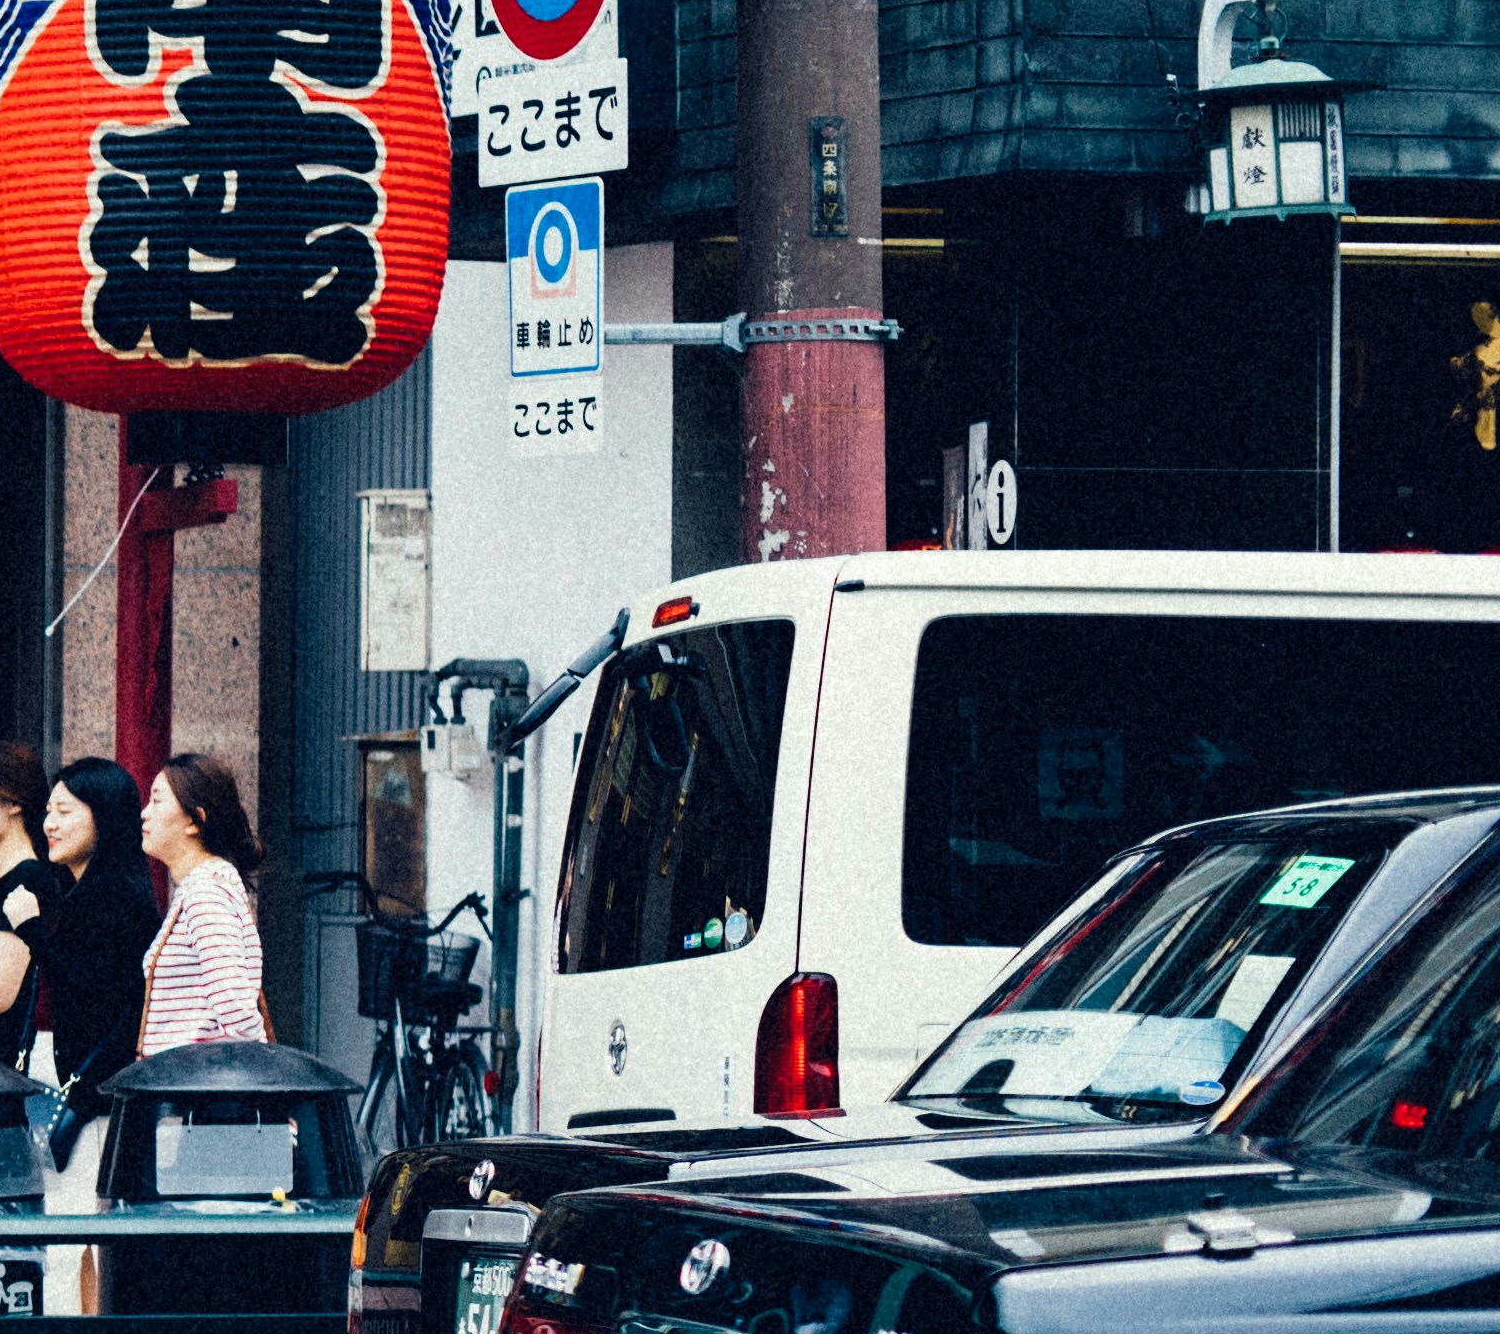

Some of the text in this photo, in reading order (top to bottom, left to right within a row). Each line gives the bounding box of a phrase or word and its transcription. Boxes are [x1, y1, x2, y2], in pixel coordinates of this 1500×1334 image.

[487, 86, 619, 157] ここまで
[515, 315, 595, 350] 車輪止め
[513, 395, 598, 439] ここまで
